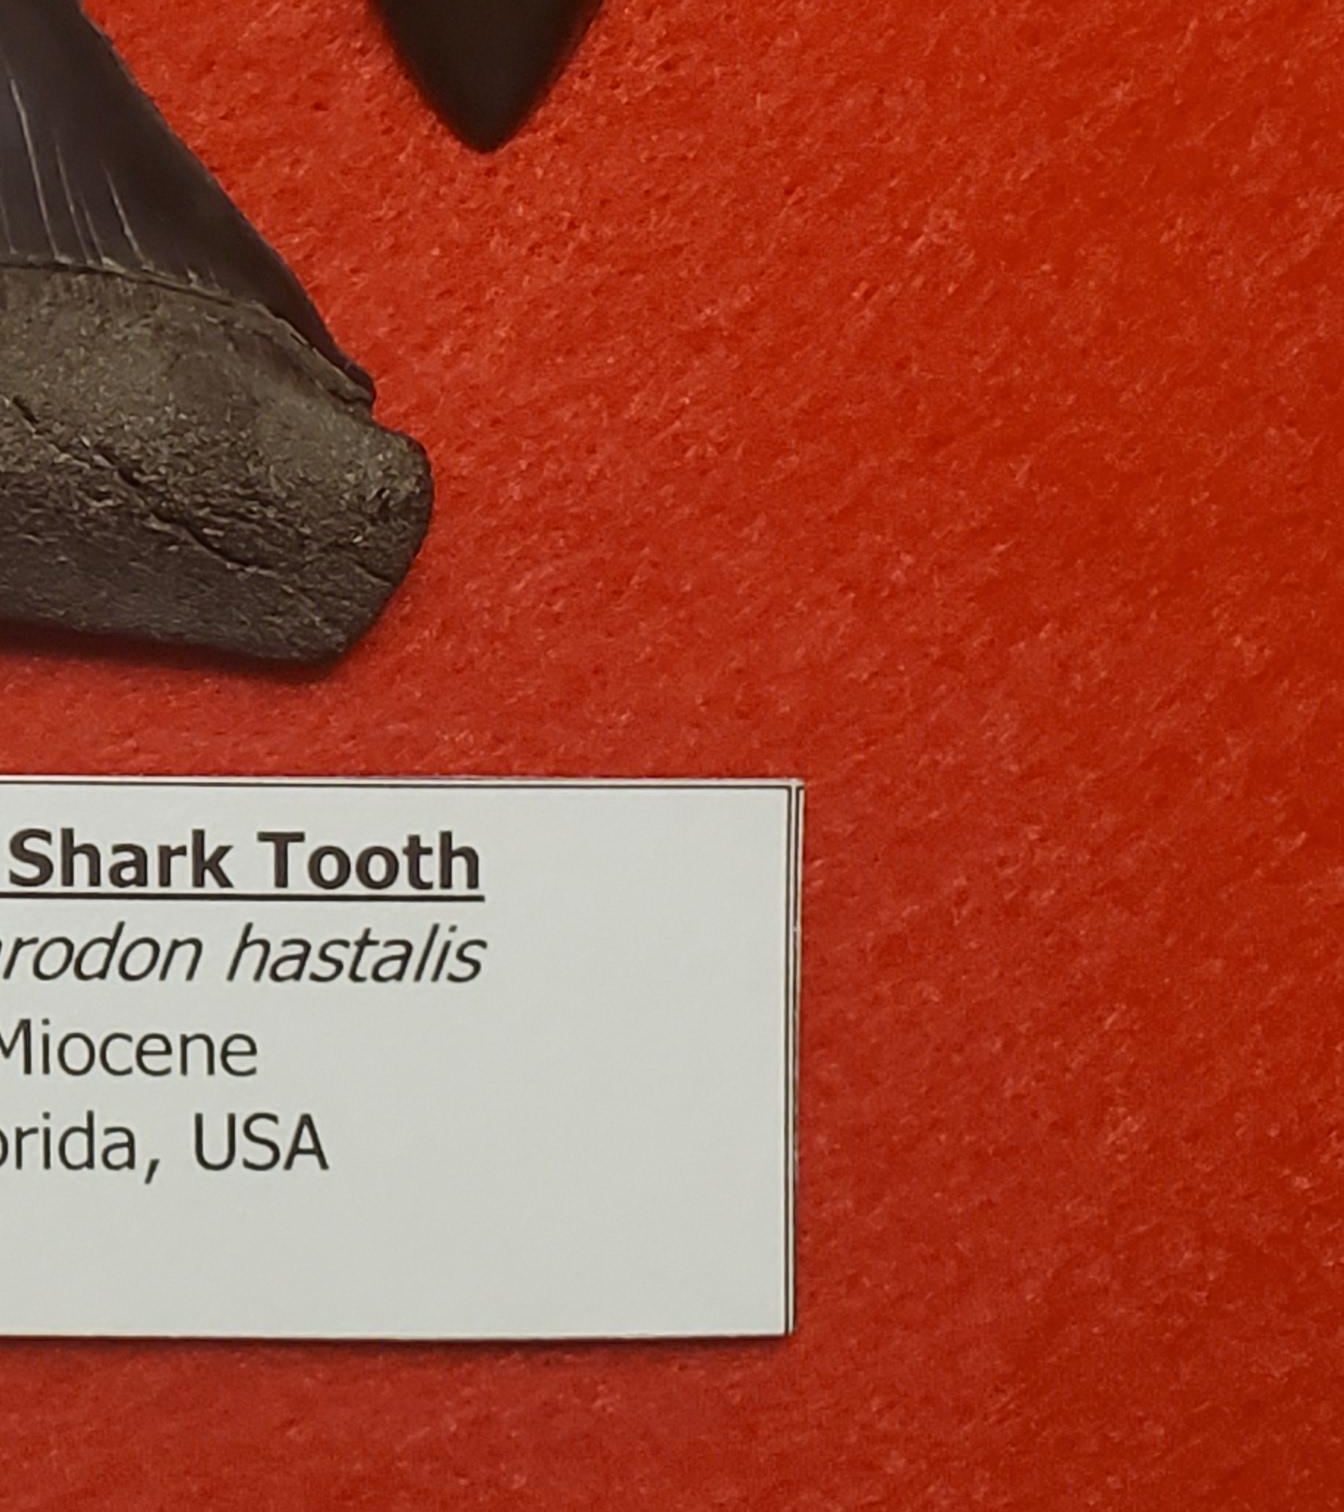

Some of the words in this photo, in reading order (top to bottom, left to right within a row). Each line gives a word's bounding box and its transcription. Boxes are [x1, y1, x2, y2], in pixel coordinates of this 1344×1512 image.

[8, 826, 235, 890] Shark
[256, 829, 480, 892] Tooth
[225, 921, 489, 984] hastalis
[193, 1111, 330, 1173] USA
